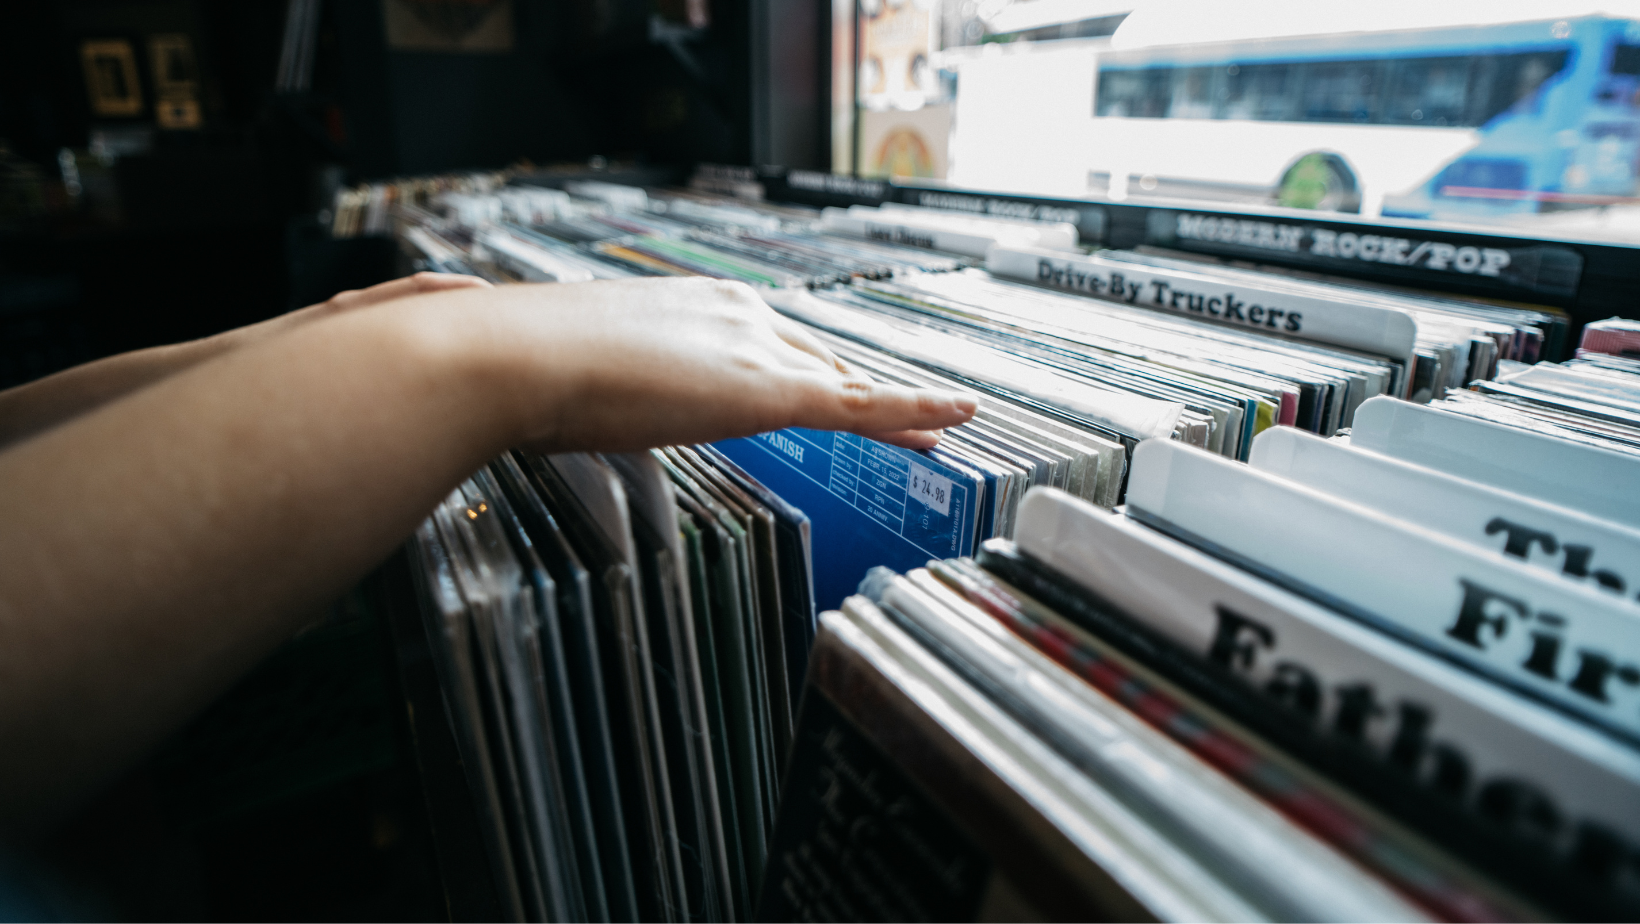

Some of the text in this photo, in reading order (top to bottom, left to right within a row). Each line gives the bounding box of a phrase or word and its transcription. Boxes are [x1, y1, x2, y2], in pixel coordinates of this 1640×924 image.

[1177, 214, 1511, 277] MODERN ROCK/POP
[1037, 257, 1303, 332] Drive-By Truckers
[913, 475, 945, 504] $ 24.98
